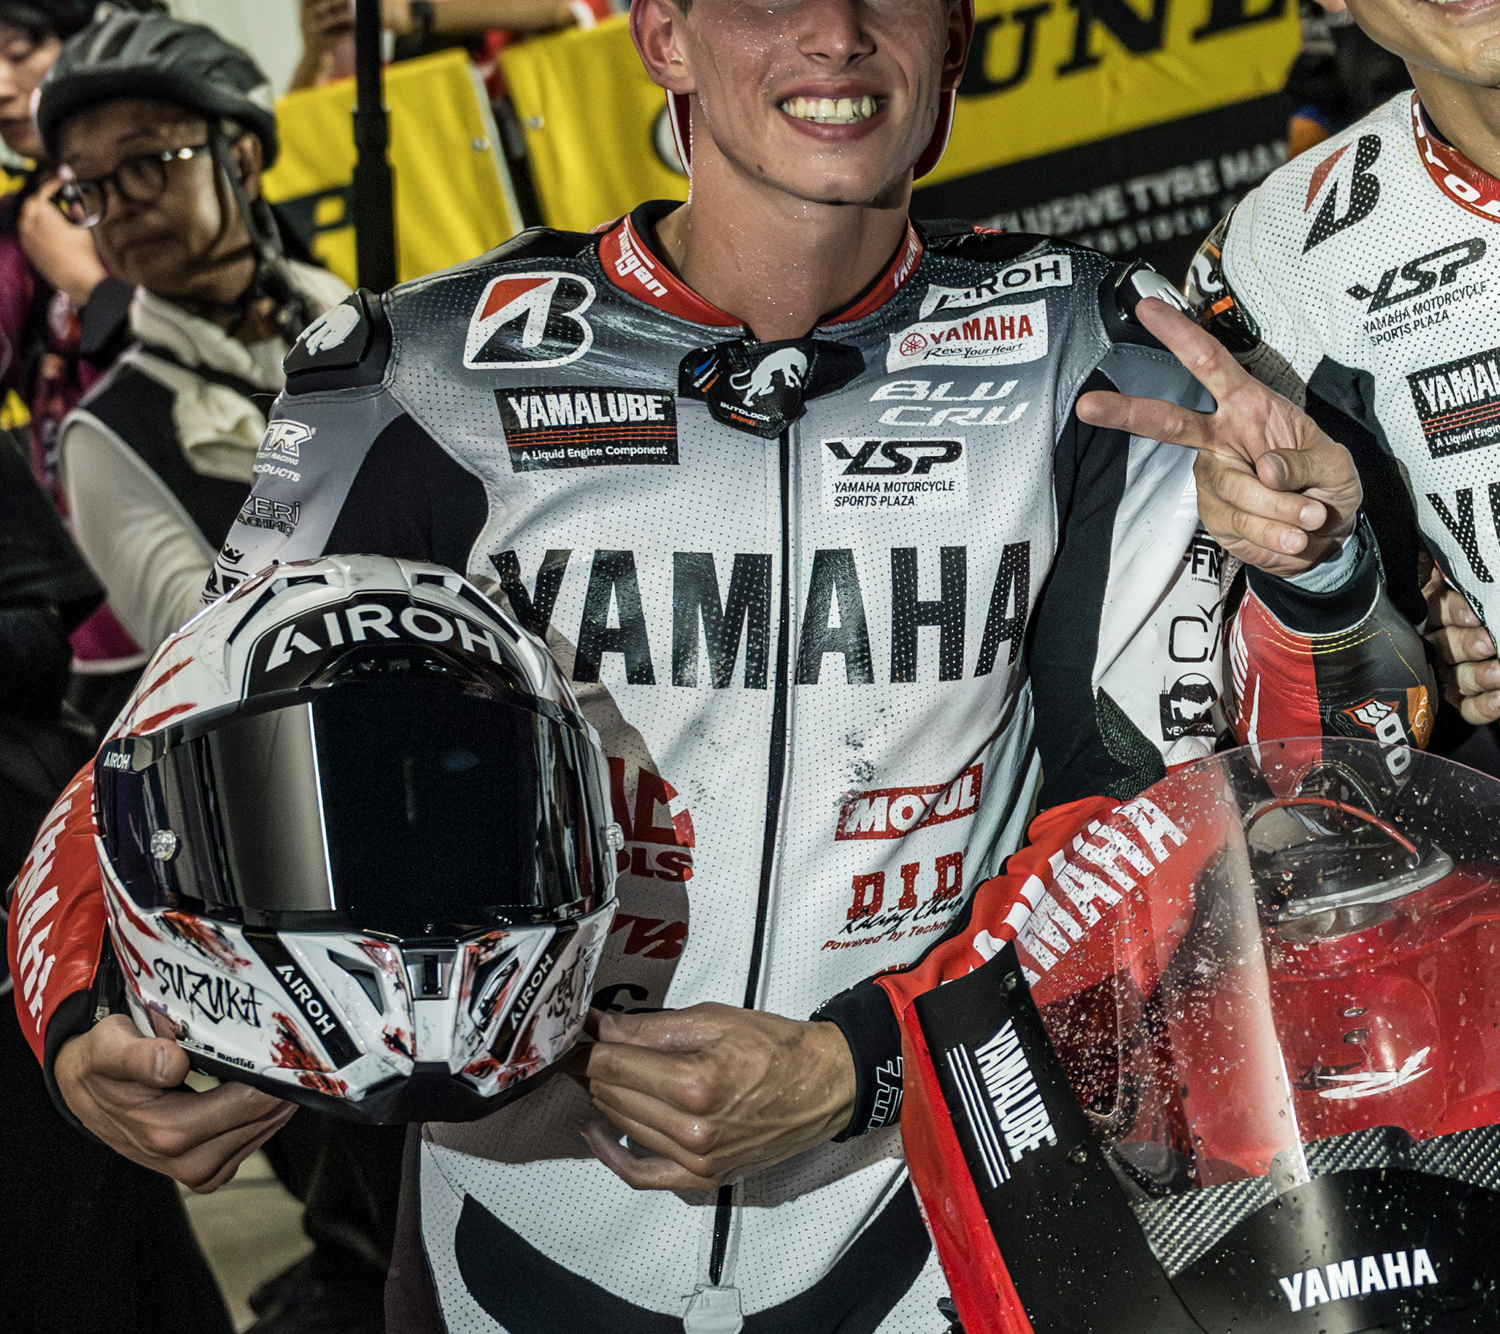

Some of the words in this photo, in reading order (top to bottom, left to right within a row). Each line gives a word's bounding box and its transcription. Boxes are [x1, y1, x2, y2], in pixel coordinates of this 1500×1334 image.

[1128, 162, 1220, 214] TYRE
[934, 260, 1061, 312] AIROH
[1345, 237, 1487, 314] YSP
[1363, 305, 1411, 334] YAMAHA
[1413, 281, 1488, 317] MOTORCYCLE
[930, 314, 1033, 345] YAMAHA
[1370, 324, 1411, 347] SPORTS
[1413, 310, 1450, 332] PLAZA
[923, 345, 963, 360] Revs
[963, 344, 992, 359] Your
[991, 342, 1024, 355] Heart
[869, 380, 1019, 402] BLU
[508, 393, 664, 429] YAMALUBE
[878, 401, 1030, 427] CRU
[521, 451, 530, 461] A
[532, 448, 565, 461] Liquid
[567, 447, 602, 459] Engine
[605, 445, 668, 457] Component
[1436, 437, 1444, 448] A
[1446, 428, 1473, 448] Liquid
[824, 440, 963, 476] YSP
[833, 482, 880, 493] YAMAHA
[884, 480, 955, 493] MOTORCYCLE
[834, 496, 877, 507] SPORTS
[880, 495, 915, 507] PLAZA
[488, 540, 1032, 689] YAMAHA
[265, 603, 503, 672] AIROH
[103, 752, 131, 769] AIROH
[845, 772, 976, 835] MOTUL
[839, 905, 915, 934] Racing
[821, 933, 884, 951] Powered
[888, 930, 905, 942] by
[153, 958, 263, 1028] SUZUKA
[275, 965, 336, 1036] AIROH
[511, 953, 553, 1029] AIROH
[974, 1018, 1053, 1163] YAMALUBE
[1278, 1248, 1439, 1312] YAMAHA
